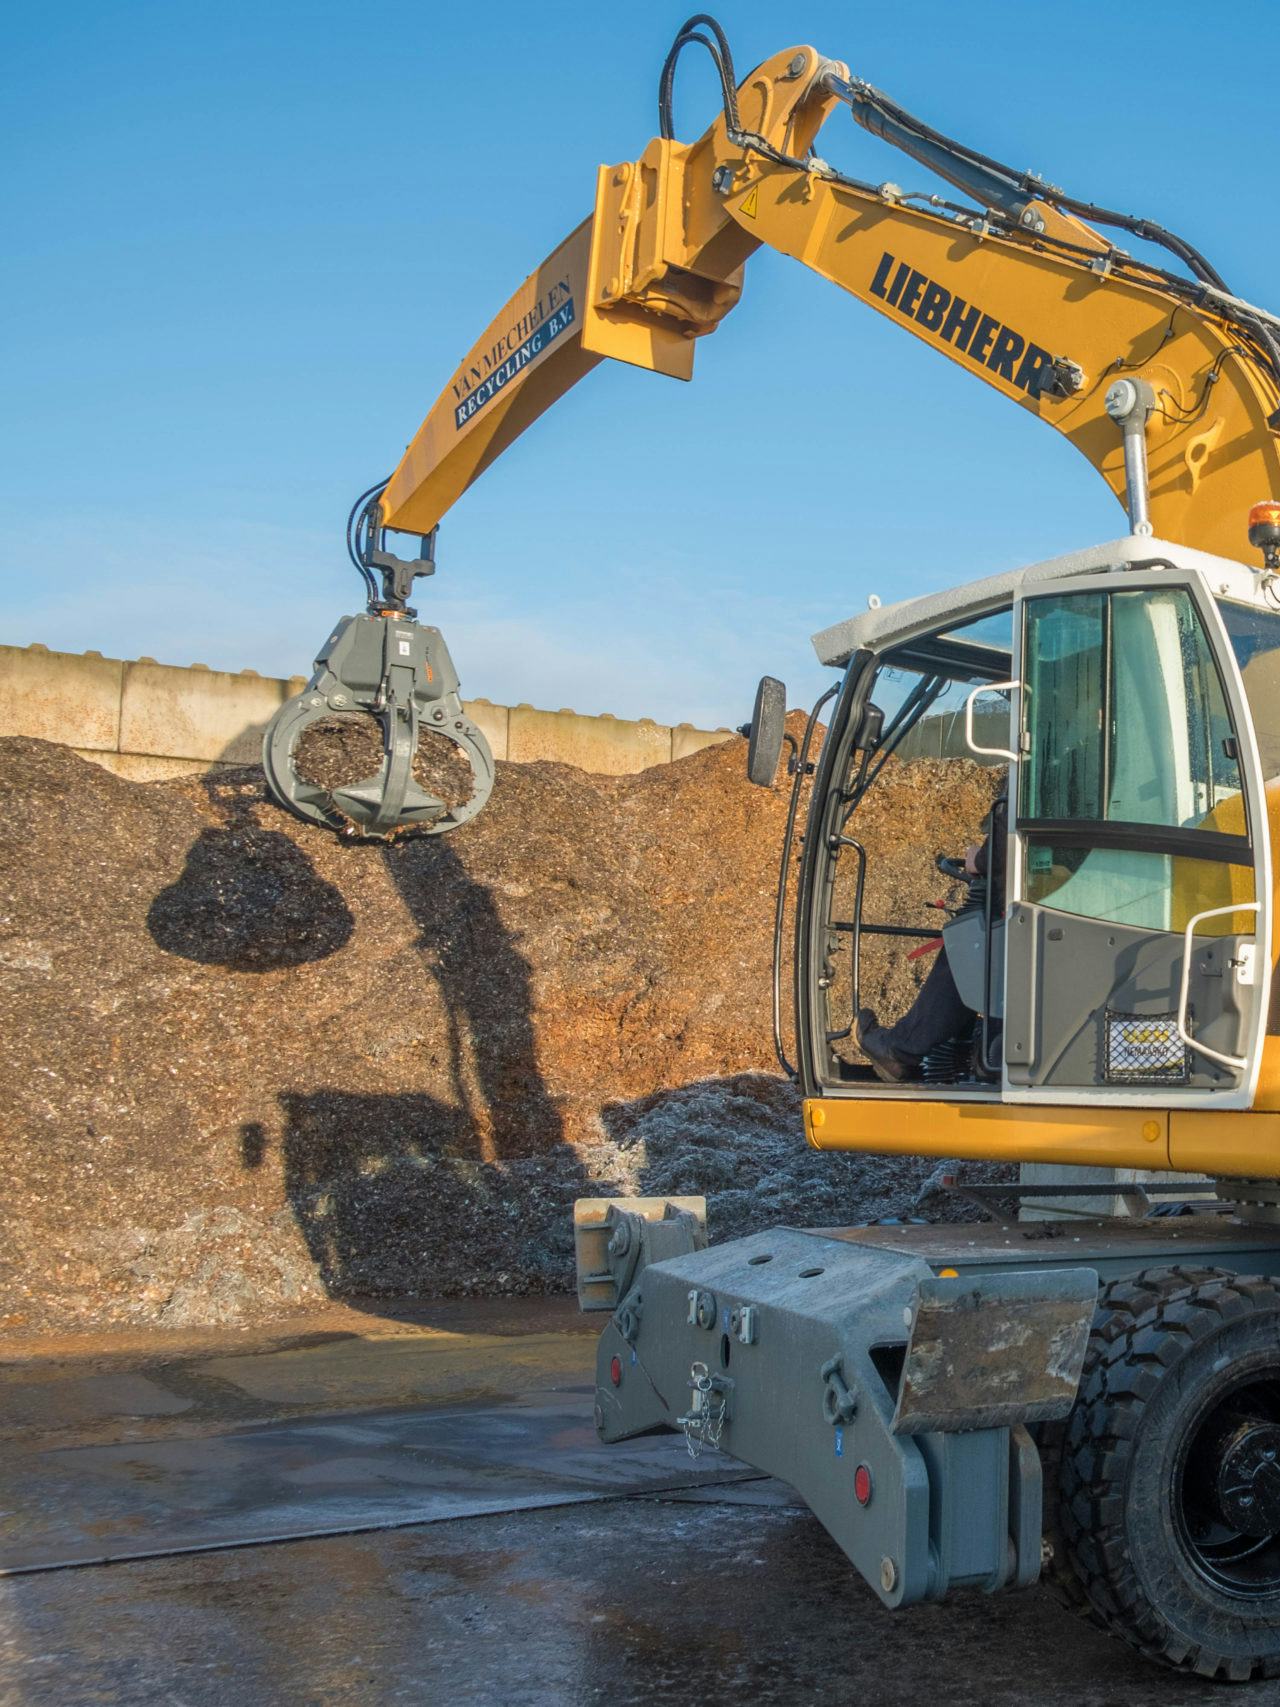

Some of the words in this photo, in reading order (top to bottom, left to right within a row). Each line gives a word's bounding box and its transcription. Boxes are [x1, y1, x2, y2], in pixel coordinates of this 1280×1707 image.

[457, 333, 542, 426] RECYCLING
[549, 305, 572, 338] B.V.
[869, 251, 1053, 401] LIEBHERR
